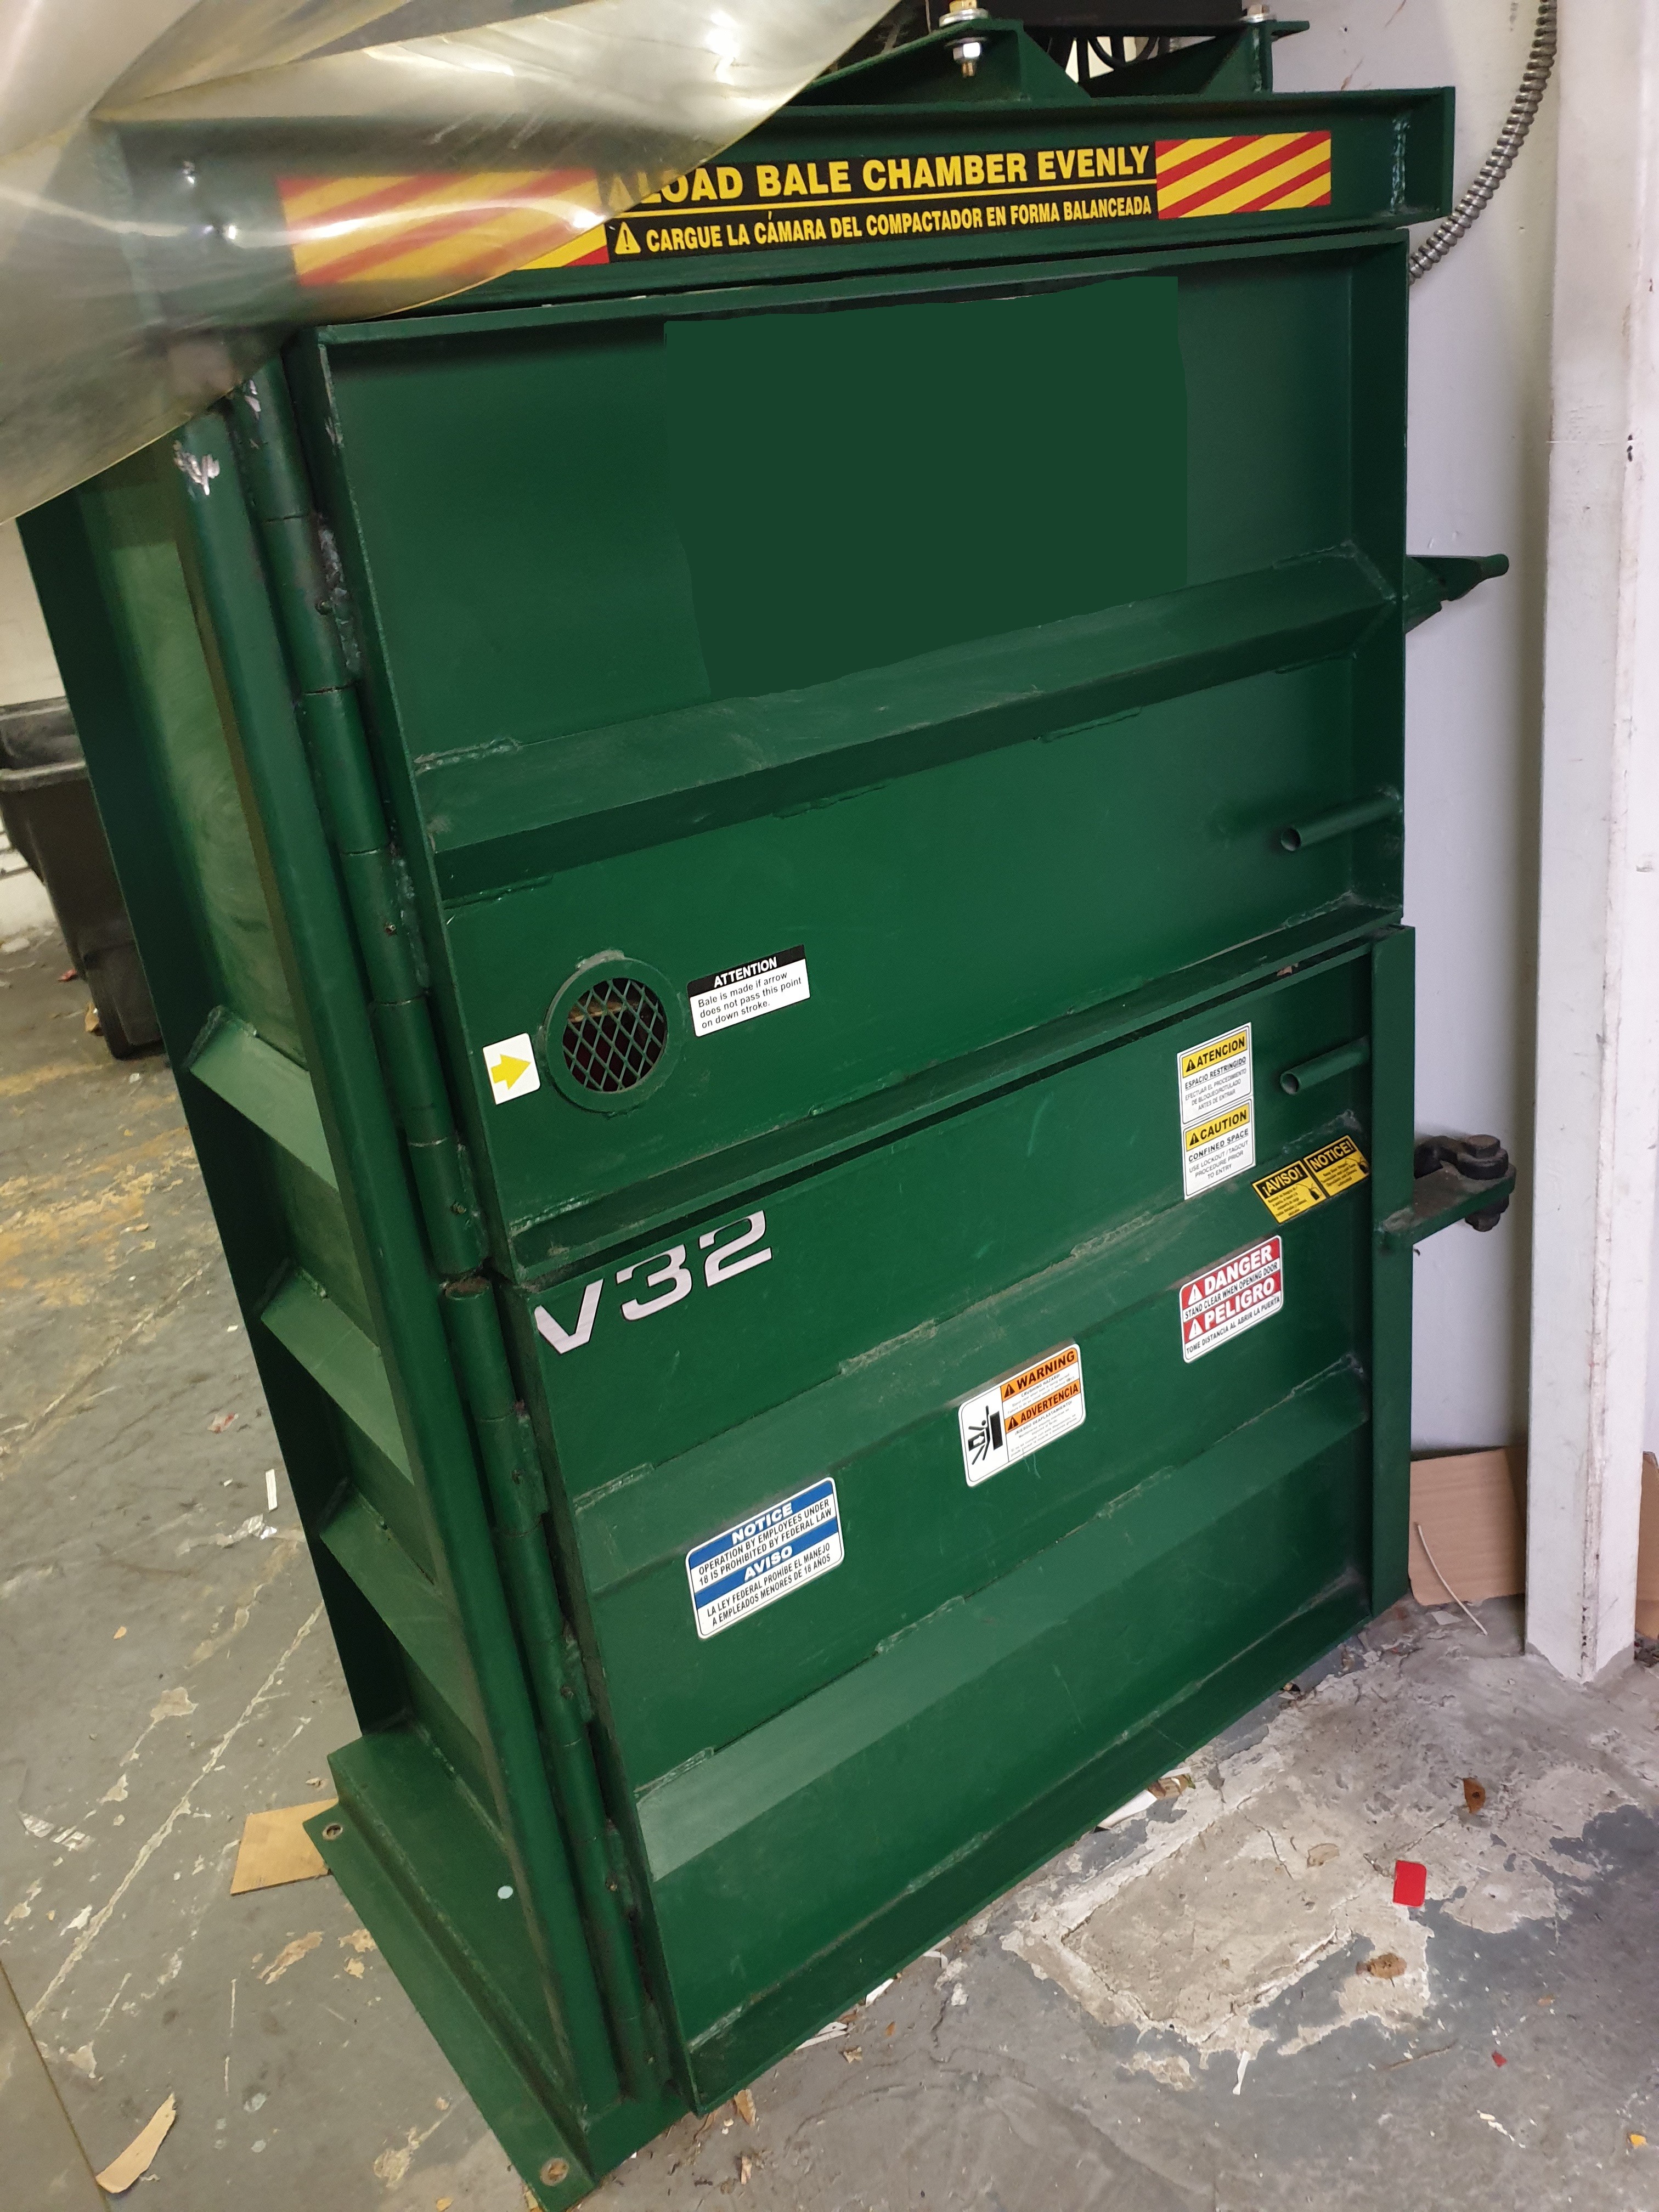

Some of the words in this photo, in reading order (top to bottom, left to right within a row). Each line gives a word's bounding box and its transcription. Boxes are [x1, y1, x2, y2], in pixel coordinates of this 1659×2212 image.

[757, 158, 851, 199] BALE
[862, 151, 1027, 191] CHAMBER
[1038, 145, 1149, 180] EVENLY
[645, 223, 723, 252] CARGUE
[726, 223, 750, 246] LA
[753, 206, 826, 245] CÁMARA
[830, 215, 862, 239] DEL
[865, 206, 983, 237] COMPACTADOR
[987, 205, 1005, 227] EN
[1011, 202, 1057, 225] FORMA
[1063, 195, 1151, 222] BALANCEADA
[698, 994, 717, 1007] Bale
[719, 991, 727, 1000] is
[730, 981, 753, 997] made
[755, 979, 761, 988] if
[763, 972, 787, 985] arrow
[713, 956, 777, 988] ATTENTION
[699, 1004, 721, 1018] does
[723, 998, 737, 1010] not
[740, 992, 760, 1006] pass
[762, 984, 778, 996] this
[780, 976, 801, 992] point
[701, 1019, 713, 1029] on
[715, 1009, 738, 1024] down
[741, 997, 770, 1015] stroke.
[1197, 1036, 1244, 1067] ATENCION
[1185, 1073, 1208, 1089] ESPACIO
[1210, 1056, 1246, 1078] RESTRINGIDO
[1185, 1086, 1206, 1101] EFECTUAR
[1198, 1099, 1211, 1110] ANTES
[1219, 1088, 1235, 1101] ENTRAR
[1200, 1109, 1246, 1141] CAUTION
[1188, 1139, 1224, 1162] CONFINED
[1227, 1127, 1248, 1144] SPACE
[1189, 1164, 1199, 1173] USE
[1201, 1151, 1224, 1167] LOCKOUT
[1228, 1139, 1248, 1154] TAGOUT
[1195, 1158, 1226, 1178] PROCEDURE
[1228, 1149, 1243, 1162] PRIOR
[1310, 1141, 1353, 1170] NOTICE!
[1207, 1171, 1214, 1180] TO
[1215, 1163, 1231, 1176] ENTRY
[1262, 1167, 1303, 1195] ¡AVISO!
[534, 1210, 772, 1354] V32
[1204, 1244, 1272, 1295] DANGER
[1185, 1303, 1202, 1319] STAND
[1204, 1293, 1221, 1309] CLEAR
[1222, 1283, 1237, 1299] WHEN
[1239, 1269, 1262, 1289] OPENING
[1263, 1261, 1277, 1276] DOOR
[1204, 1277, 1275, 1330] PELIGRO
[1187, 1341, 1200, 1355] TOME
[1202, 1325, 1228, 1345] DISTANCIA
[1229, 1321, 1235, 1329] AL
[1237, 1311, 1252, 1325] ABRIR
[1254, 1307, 1260, 1316] LA
[1261, 1295, 1279, 1312] PUERTA
[1016, 1351, 1075, 1390] WARNING
[1020, 1384, 1078, 1423] ADVERTENCIA
[698, 1544, 743, 1576] OPERATION
[745, 1537, 756, 1550] BY
[758, 1513, 802, 1543] EMPLOYEES
[804, 1498, 829, 1519] UNDER
[731, 1502, 793, 1545] NOTICE
[699, 1575, 708, 1586] 18
[710, 1569, 718, 1579] IS
[720, 1543, 767, 1575] PROHIBITED
[769, 1536, 780, 1548] BY
[781, 1517, 814, 1542] FEDERAL
[816, 1508, 831, 1522] LAW
[743, 1544, 793, 1581] AVISO
[707, 1605, 716, 1617] LA
[717, 1597, 730, 1611] LEY
[732, 1579, 762, 1603] FEDERAL
[763, 1561, 792, 1585] PROHÍBE
[794, 1557, 802, 1568] EL
[803, 1542, 830, 1564] MANEJO
[712, 1616, 717, 1626] A
[718, 1593, 759, 1622] EMPLEADOS
[760, 1575, 792, 1599] MENORES
[793, 1568, 802, 1580] DE
[804, 1564, 811, 1575] 18
[812, 1551, 831, 1570] AÑOS
